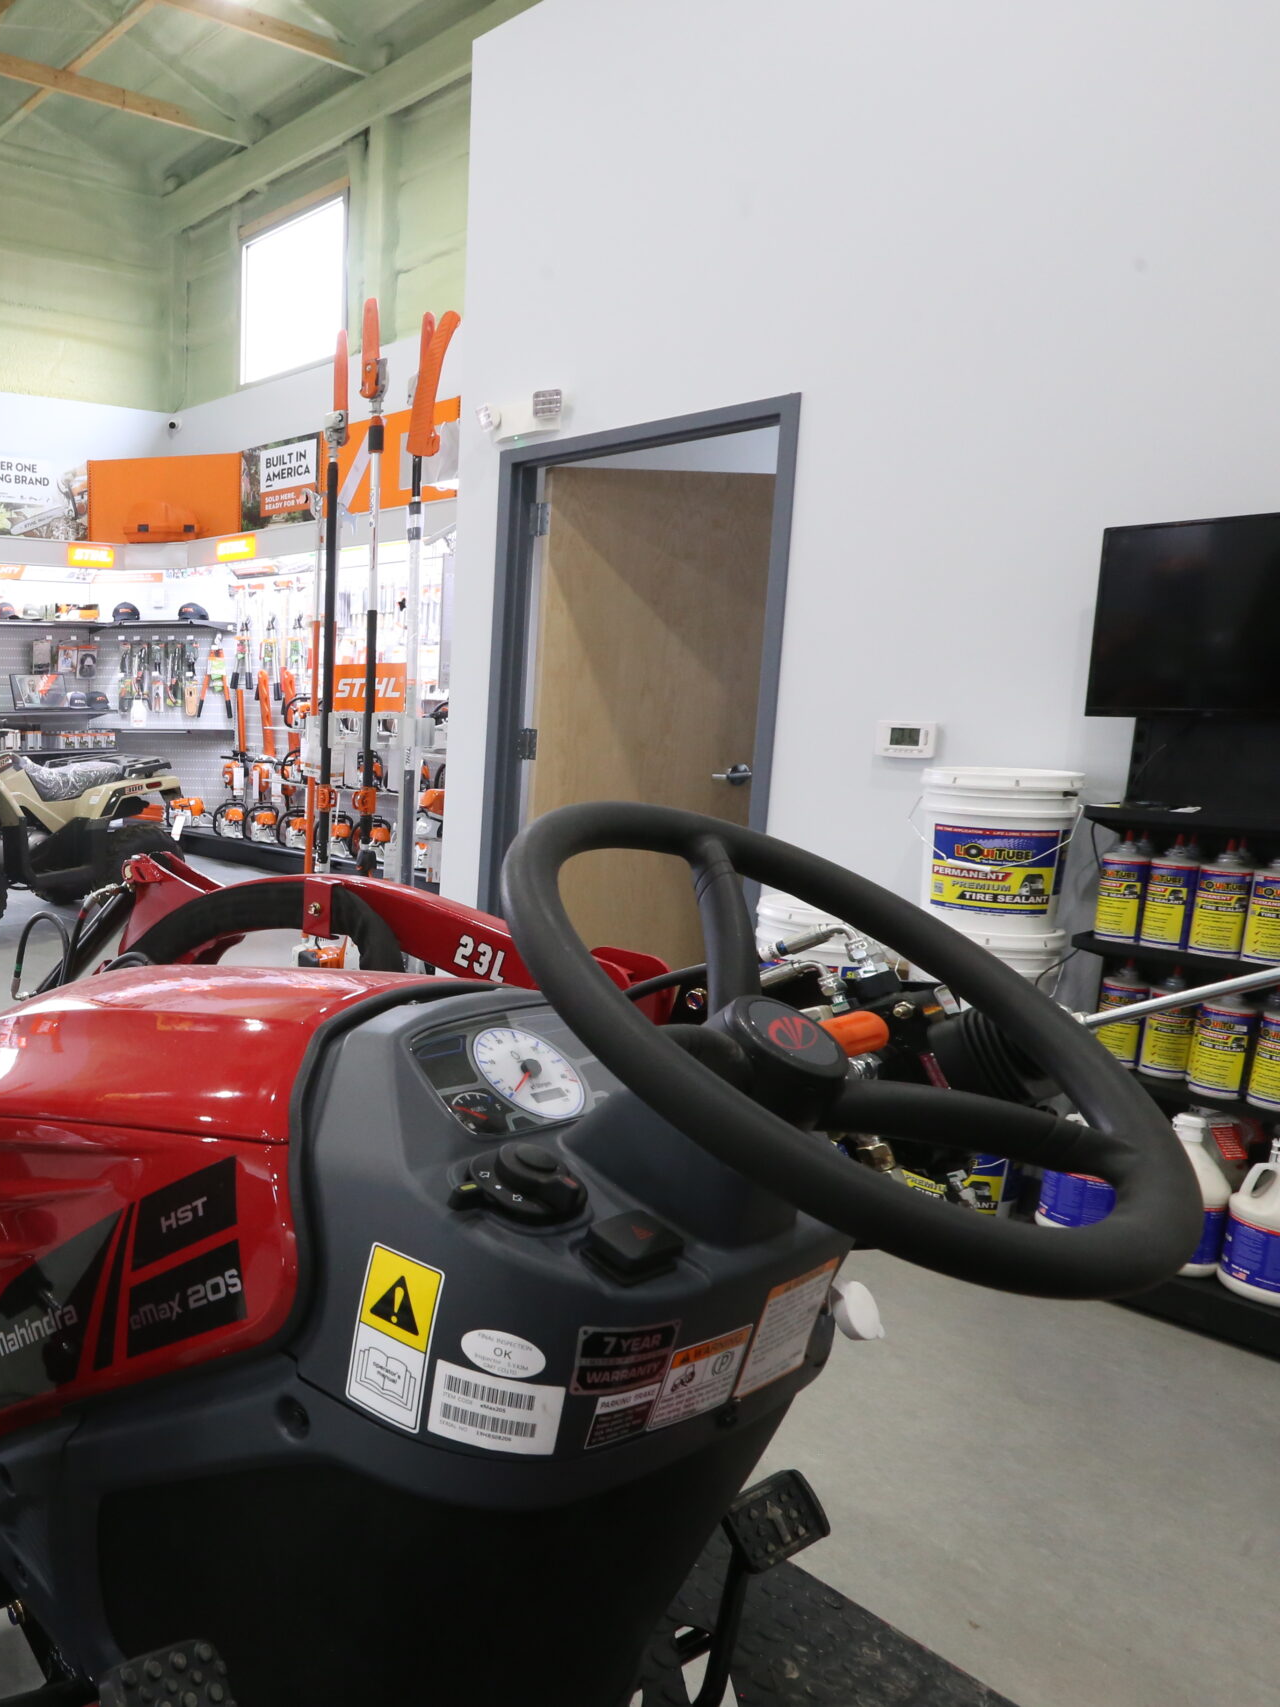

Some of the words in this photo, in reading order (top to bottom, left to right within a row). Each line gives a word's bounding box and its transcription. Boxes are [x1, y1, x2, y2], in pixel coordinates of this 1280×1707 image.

[265, 453, 293, 469] BUILT
[296, 450, 307, 463] IN
[15, 463, 37, 474] ONE
[265, 463, 310, 483] AMERICA
[14, 475, 50, 487] BRAND
[265, 495, 280, 504] SOLD
[265, 501, 283, 511] READY
[933, 865, 1006, 880] PERMANENT
[951, 880, 1011, 892] PREMIUM
[963, 891, 993, 902] TIRE
[996, 894, 1048, 904] SEALANT
[453, 934, 505, 984] 23L
[160, 1197, 208, 1234] HST
[130, 1294, 181, 1331] eMax
[602, 1336, 618, 1355] 7
[620, 1333, 662, 1353] YEAR
[493, 1347, 512, 1360] OK
[376, 1370, 398, 1385] manual
[586, 1361, 658, 1384] WARRANTY
[599, 1396, 632, 1409] PARKING
[633, 1389, 656, 1400] BRAKE
